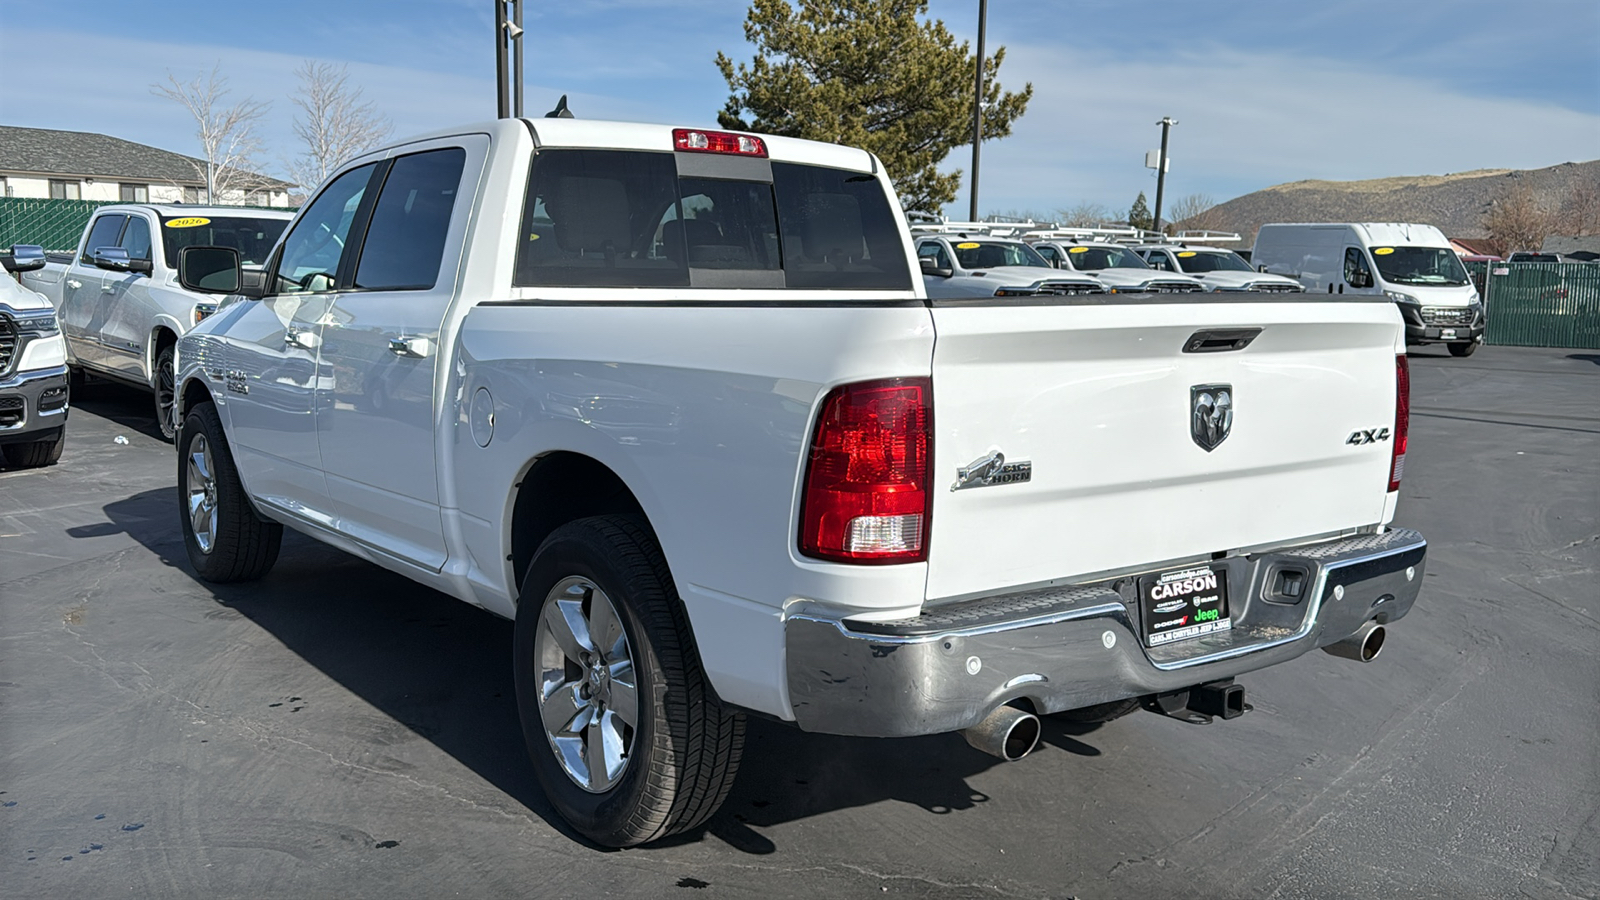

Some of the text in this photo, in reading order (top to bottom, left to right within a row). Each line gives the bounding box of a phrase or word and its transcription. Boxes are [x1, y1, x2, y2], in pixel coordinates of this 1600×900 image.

[175, 218, 203, 226] 2026
[992, 472, 1030, 484] HORN
[1151, 575, 1217, 599] CARSON
[1194, 609, 1218, 621] Jeep
